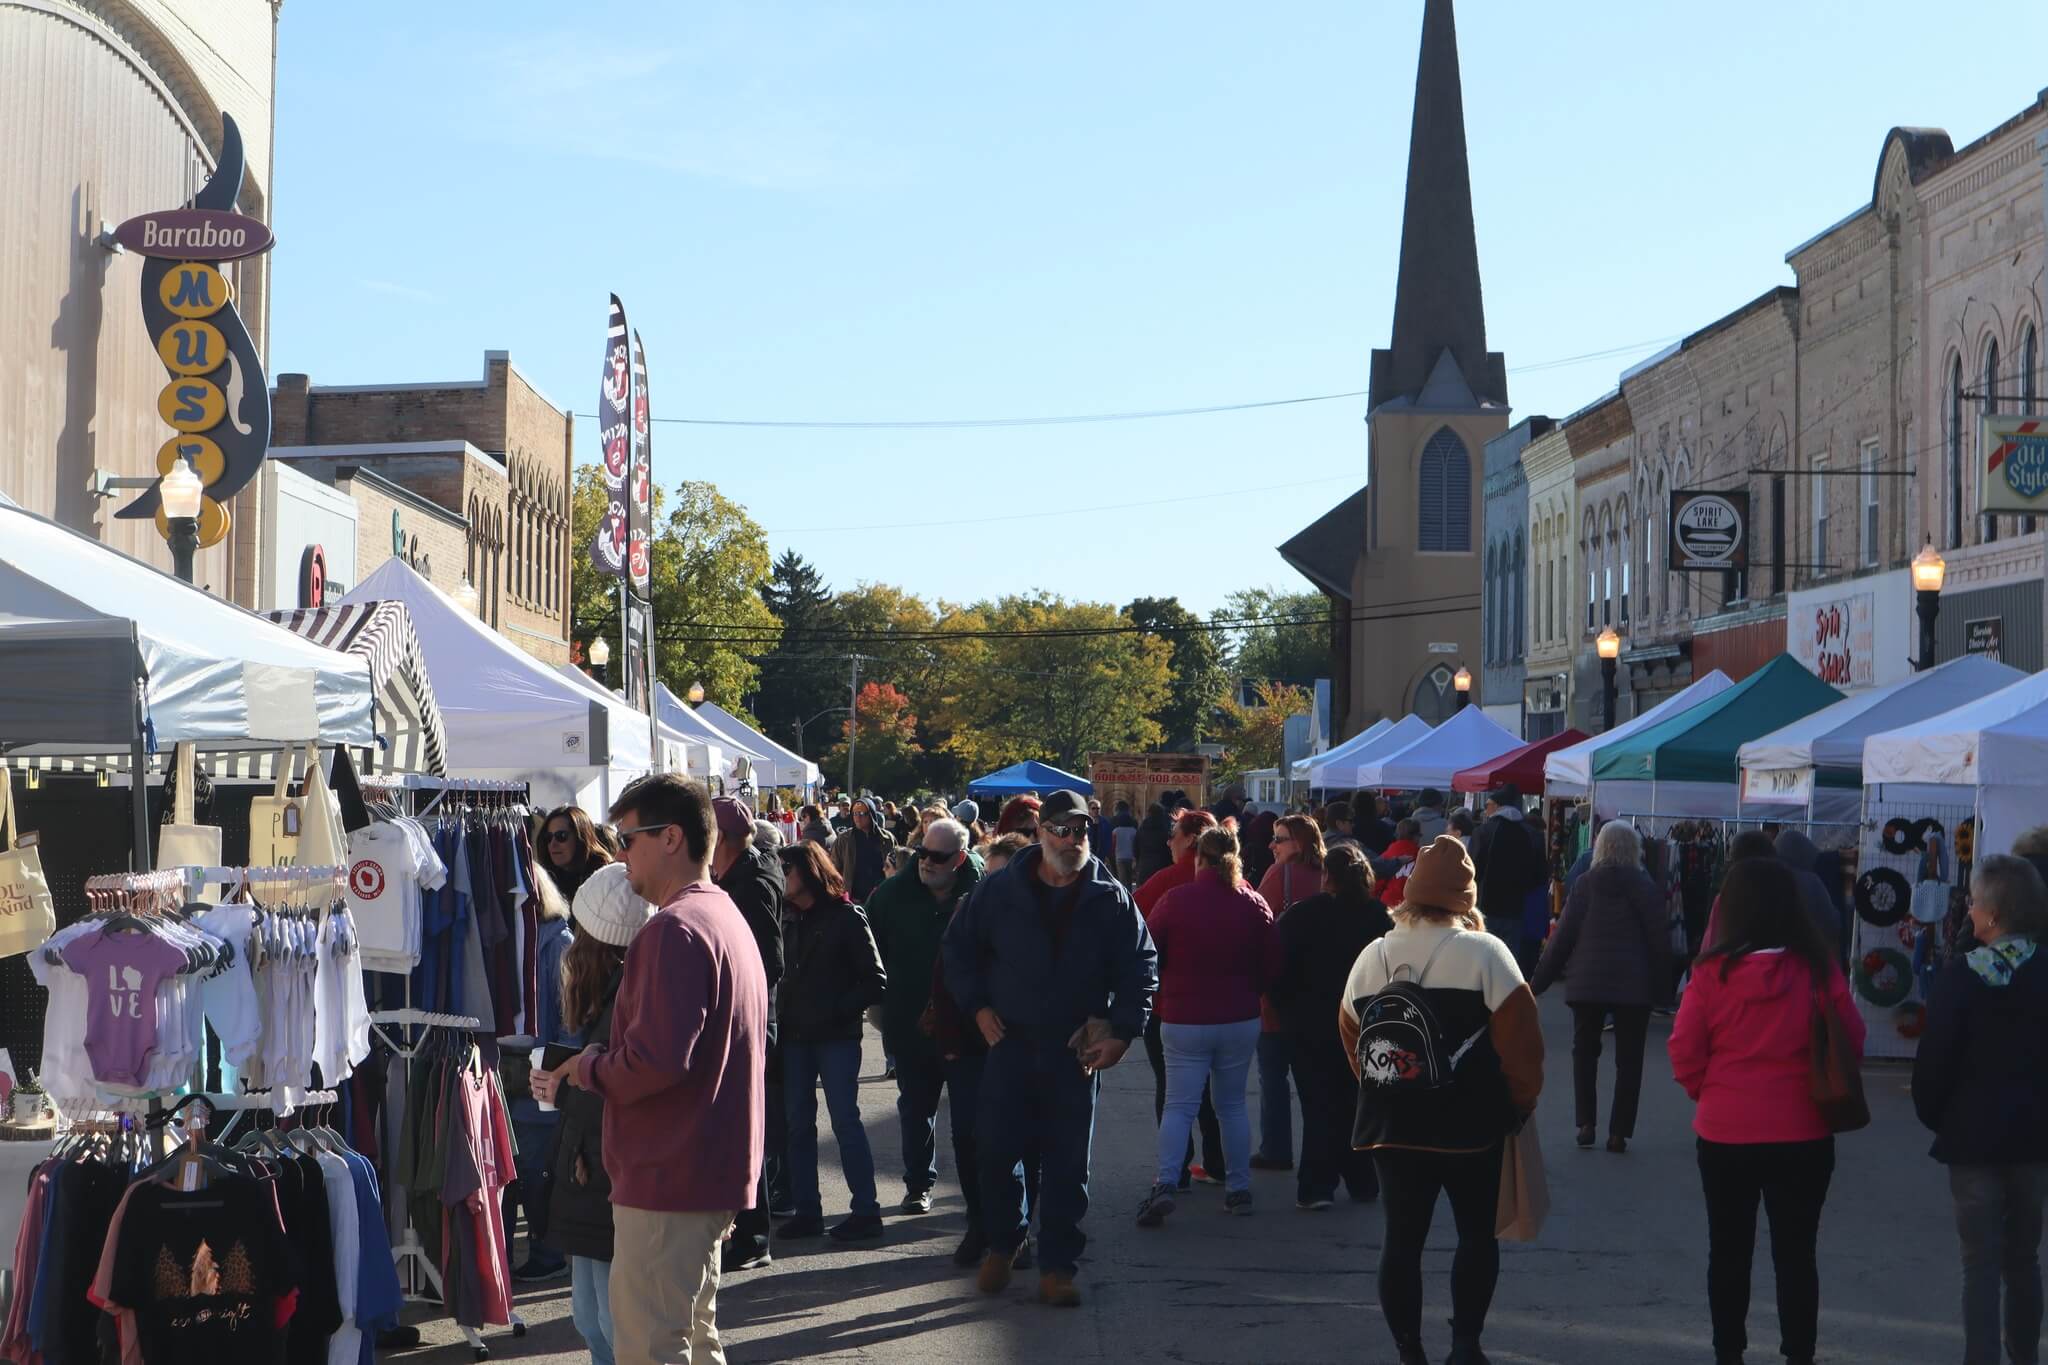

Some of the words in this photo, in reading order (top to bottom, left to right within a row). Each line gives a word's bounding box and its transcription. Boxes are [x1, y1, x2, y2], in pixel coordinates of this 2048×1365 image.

[143, 219, 247, 249] Baraboo
[2017, 444, 2045, 465] Old
[2009, 462, 2048, 492] Style
[1693, 506, 1722, 517] SPIRIT
[1697, 517, 1718, 528] LAKE
[1402, 1006, 1420, 1021] NYC
